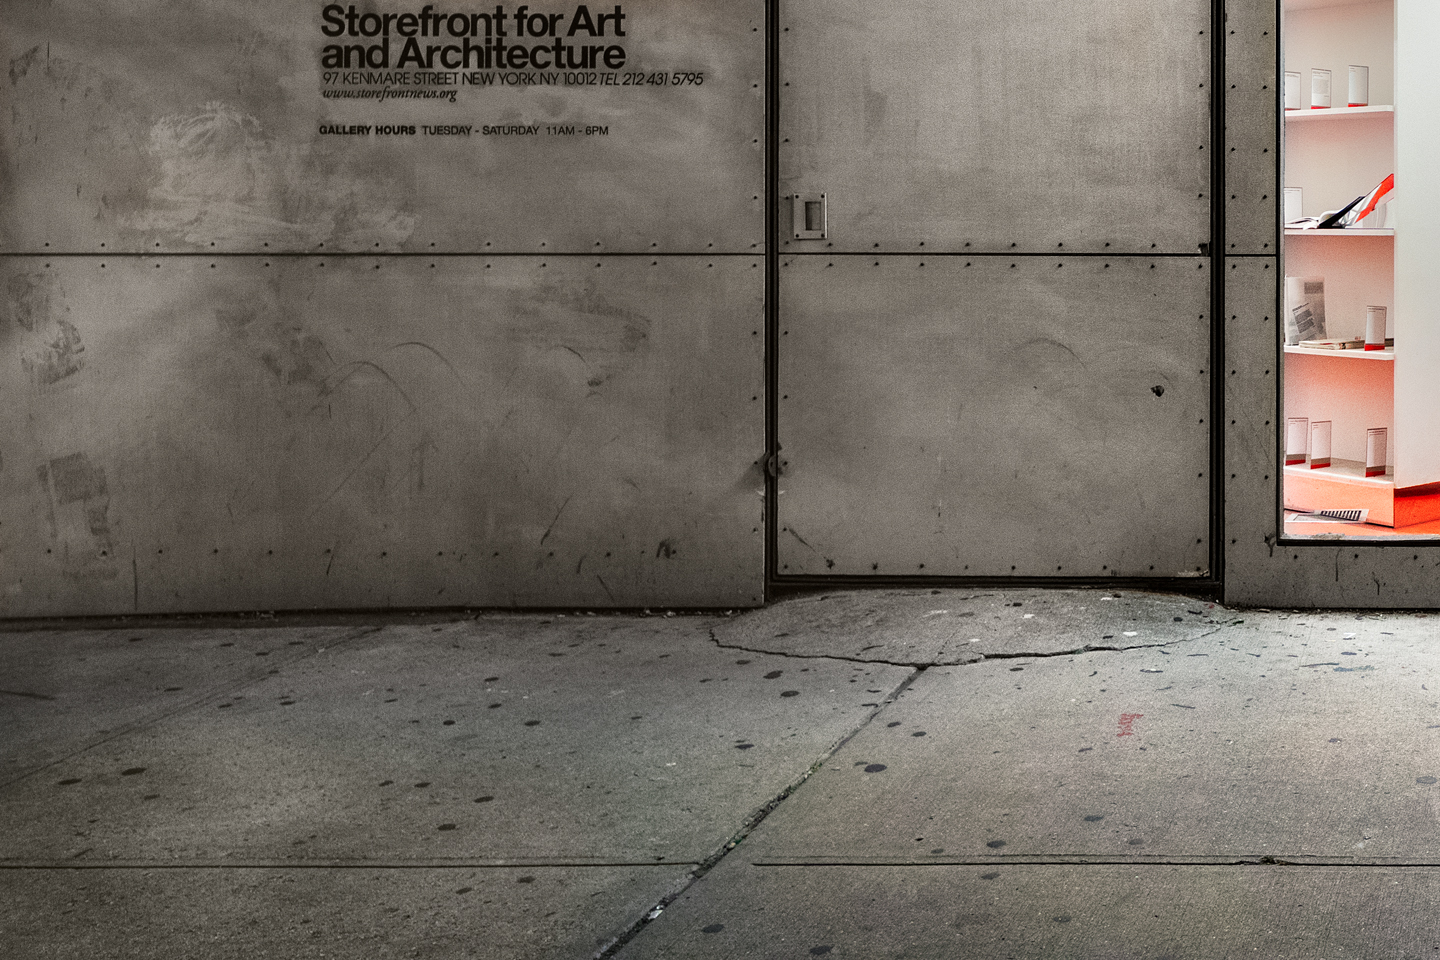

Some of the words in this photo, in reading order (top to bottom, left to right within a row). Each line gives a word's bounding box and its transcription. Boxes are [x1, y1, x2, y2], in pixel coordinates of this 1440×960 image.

[321, 3, 508, 38] Storefront
[513, 5, 564, 37] for
[566, 5, 626, 37] Art
[321, 37, 389, 69] and
[396, 36, 626, 69] Architecture
[322, 71, 339, 86] 97
[342, 71, 410, 86] KENMARE
[413, 71, 459, 86] STREET
[462, 71, 496, 86] NEW
[498, 71, 537, 86] YORK
[539, 71, 560, 86] NY
[563, 71, 598, 86] 10012
[599, 71, 621, 86] TEL
[623, 71, 646, 86] 212
[646, 71, 668, 86] 431
[671, 71, 704, 86] 5795
[322, 85, 458, 103] www.storefrontnews.org
[319, 125, 372, 136] GALLERY
[375, 125, 416, 136] HOURS
[422, 125, 472, 136] TUESDAY
[482, 125, 540, 136] SATURDAY
[545, 125, 575, 136] 11AM
[585, 125, 609, 136] 6PM
